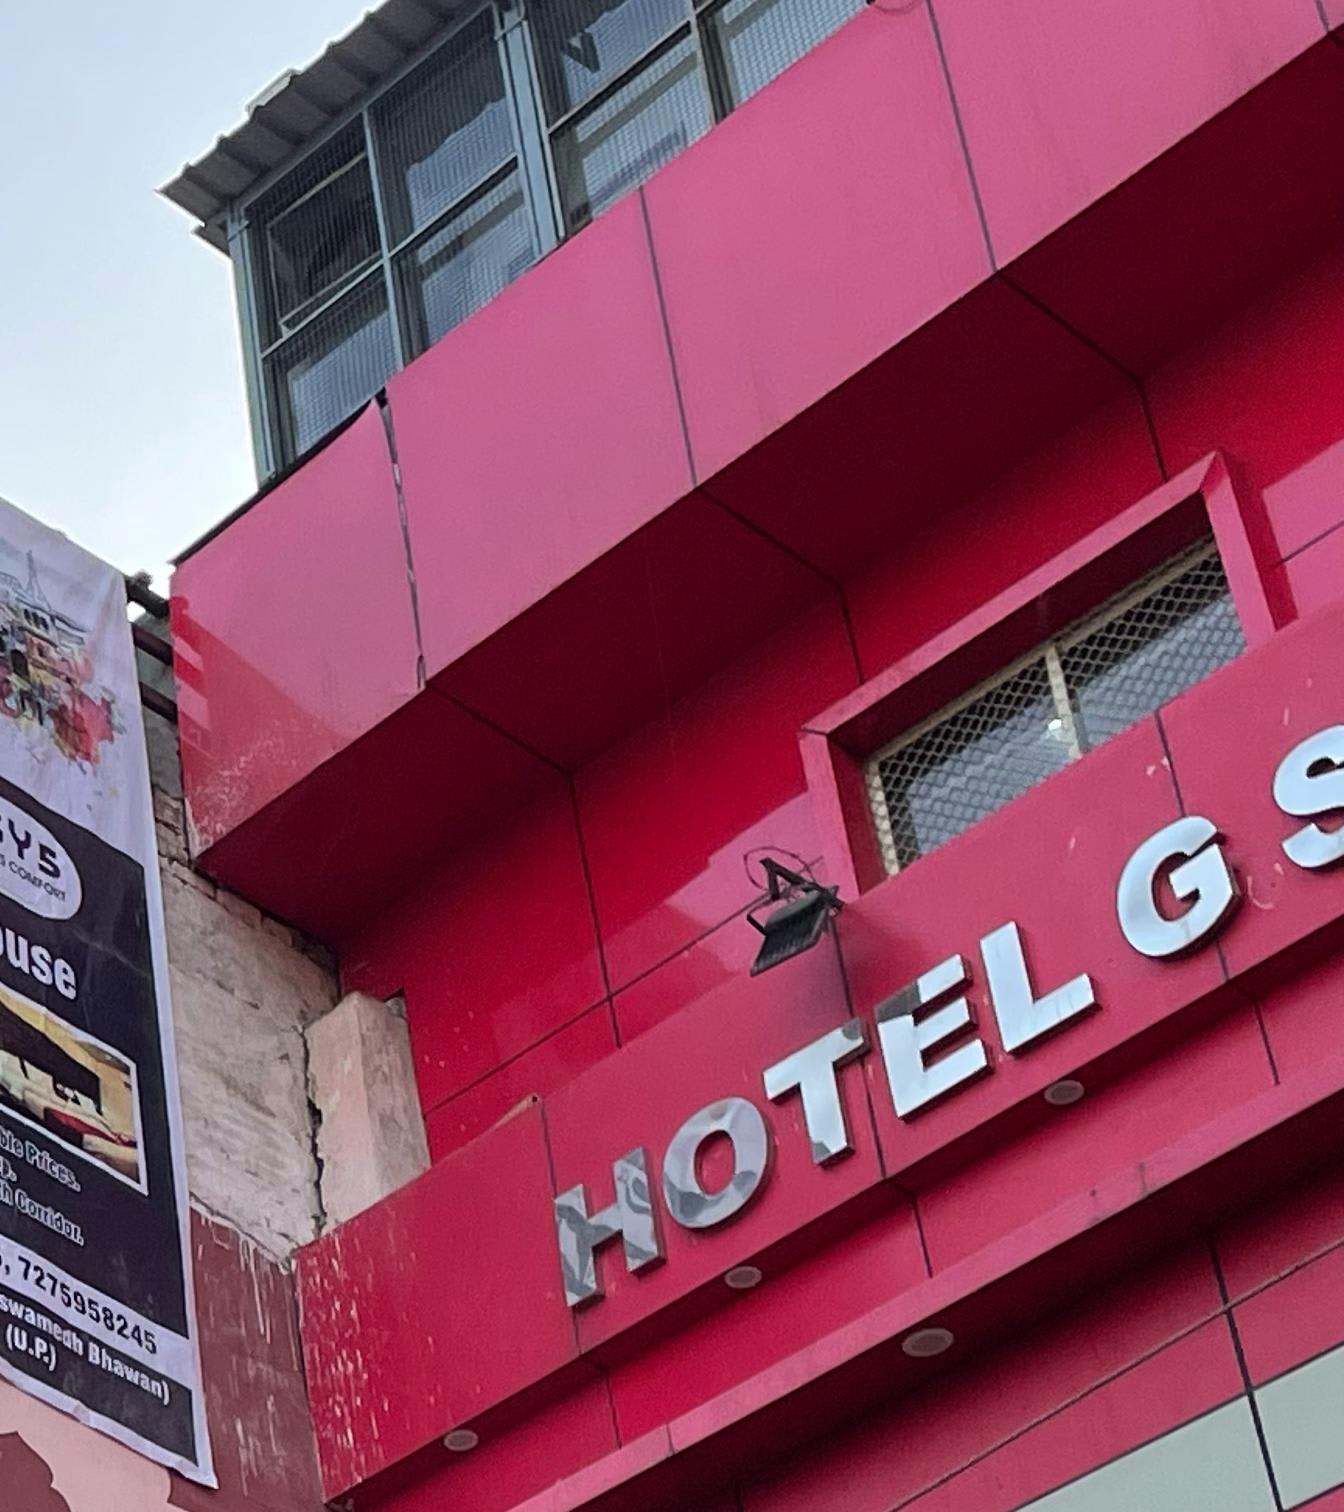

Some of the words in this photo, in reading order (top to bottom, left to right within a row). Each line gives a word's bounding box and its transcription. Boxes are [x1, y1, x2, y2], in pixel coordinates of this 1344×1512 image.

[553, 921, 1100, 1308] HOTEL
[1116, 815, 1240, 959] G
[25, 1139, 82, 1192] Prices.
[14, 1188, 85, 1246] Corridor.
[18, 1255, 159, 1355] 7275958245
[6, 1323, 58, 1372] (U.P.)
[87, 1342, 170, 1406] Bhawan)
